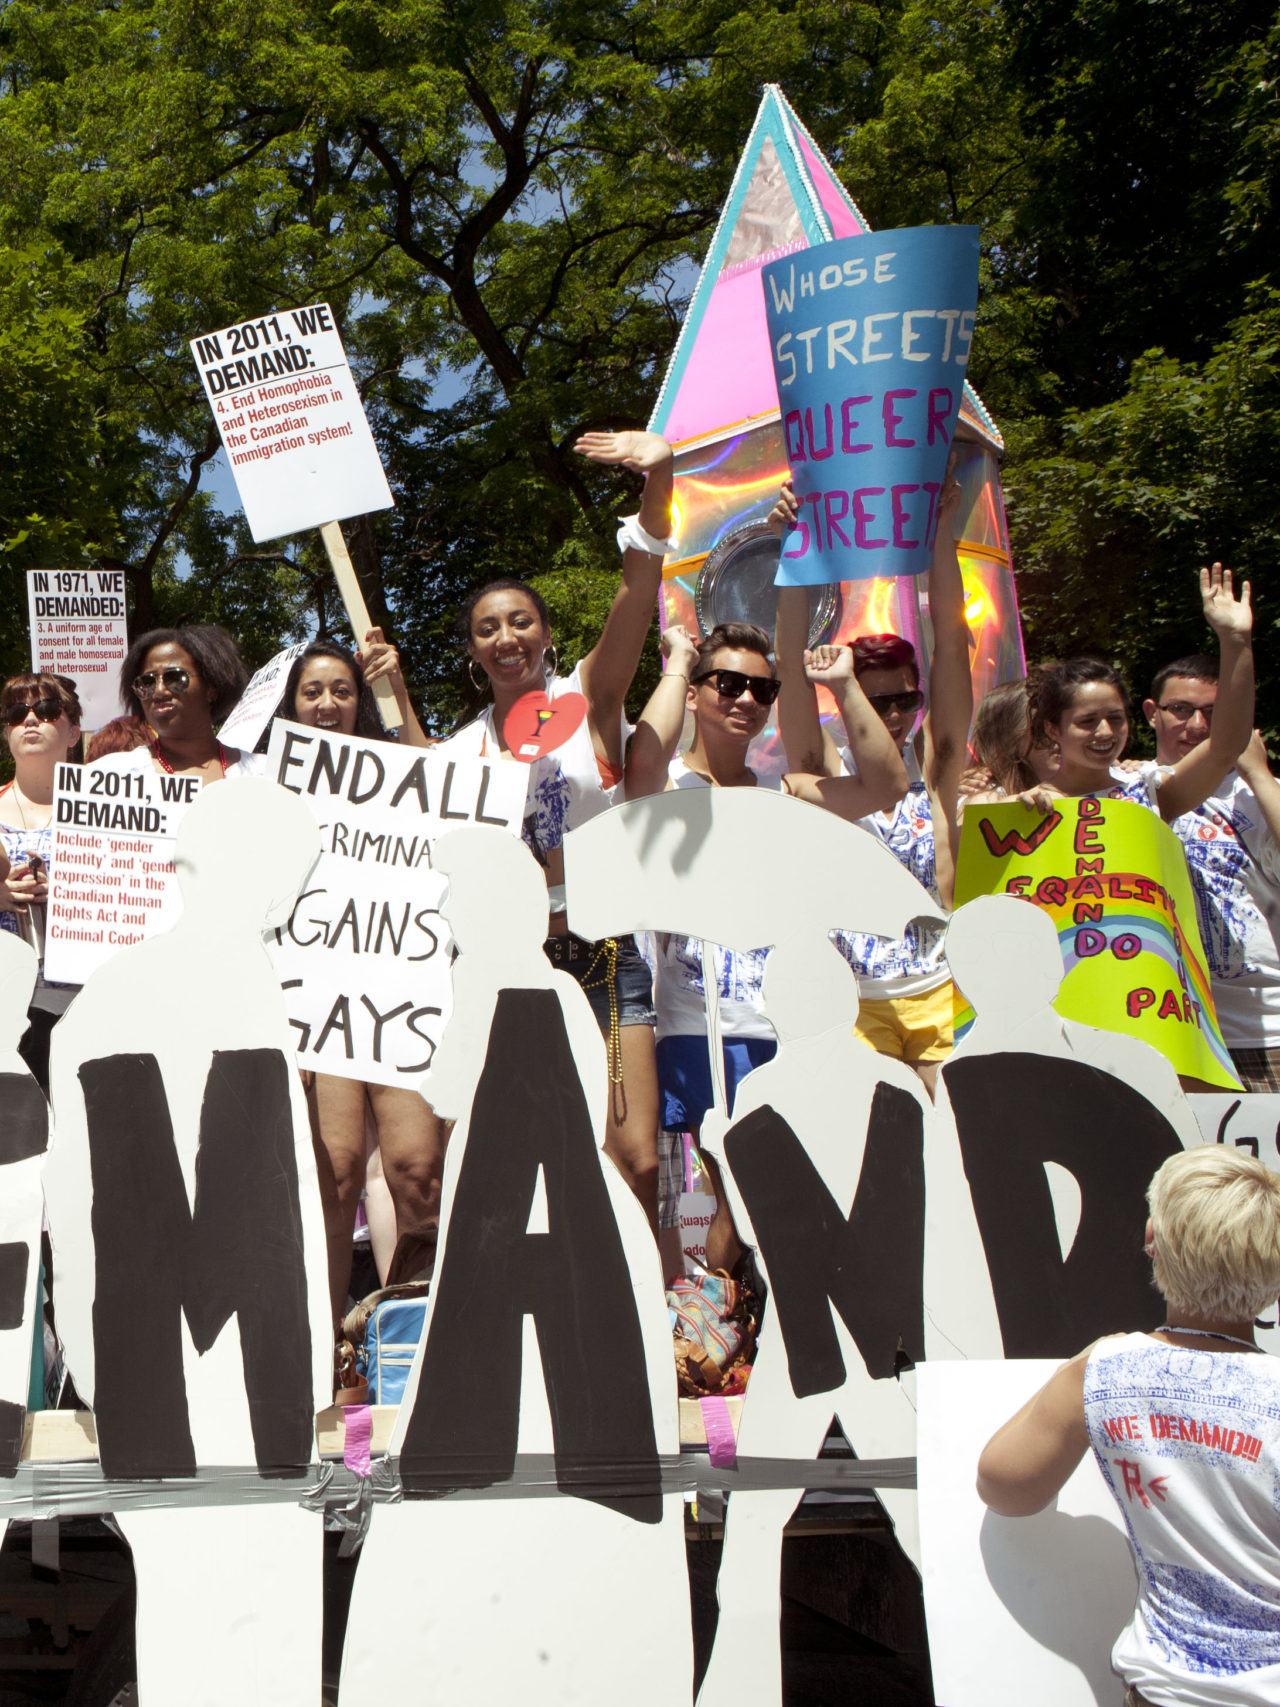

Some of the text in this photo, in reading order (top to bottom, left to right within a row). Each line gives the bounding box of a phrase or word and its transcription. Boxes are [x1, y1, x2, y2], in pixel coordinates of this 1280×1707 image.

[769, 253, 897, 315] WHOSE
[196, 306, 333, 365] IN 2011, WE
[776, 310, 977, 387] STREETS
[205, 344, 316, 395] DEMAND:
[217, 373, 332, 414] 4. End Homophobia
[222, 389, 343, 431] and Heterosexism in
[227, 417, 309, 448] the Canadian
[232, 422, 353, 465] immigration system!
[785, 388, 953, 462] QUEER
[784, 482, 941, 559] STREET
[34, 573, 123, 596] IN 1971, WE
[35, 597, 124, 617] DEMANDED:
[38, 622, 112, 636] 3. A uniform age of
[38, 635, 124, 646] consent for all female
[39, 649, 124, 660] and male homosexual
[40, 662, 108, 673] and heterosexual
[58, 766, 199, 806] IN 2011, WE
[277, 731, 509, 827] END ALL
[56, 798, 167, 834] DEMAND:
[56, 831, 102, 849] Include
[319, 822, 438, 869] RIMINA
[110, 856, 134, 870] and
[129, 875, 141, 888] in
[145, 877, 165, 891] the
[52, 904, 146, 926] Rights Act and
[53, 886, 162, 909] Canadian Human
[51, 925, 104, 943] Criminal
[275, 889, 440, 961] GAINS
[1127, 987, 1202, 1029] PART
[1102, 1414, 1263, 1463] WE DEMAND!!!
